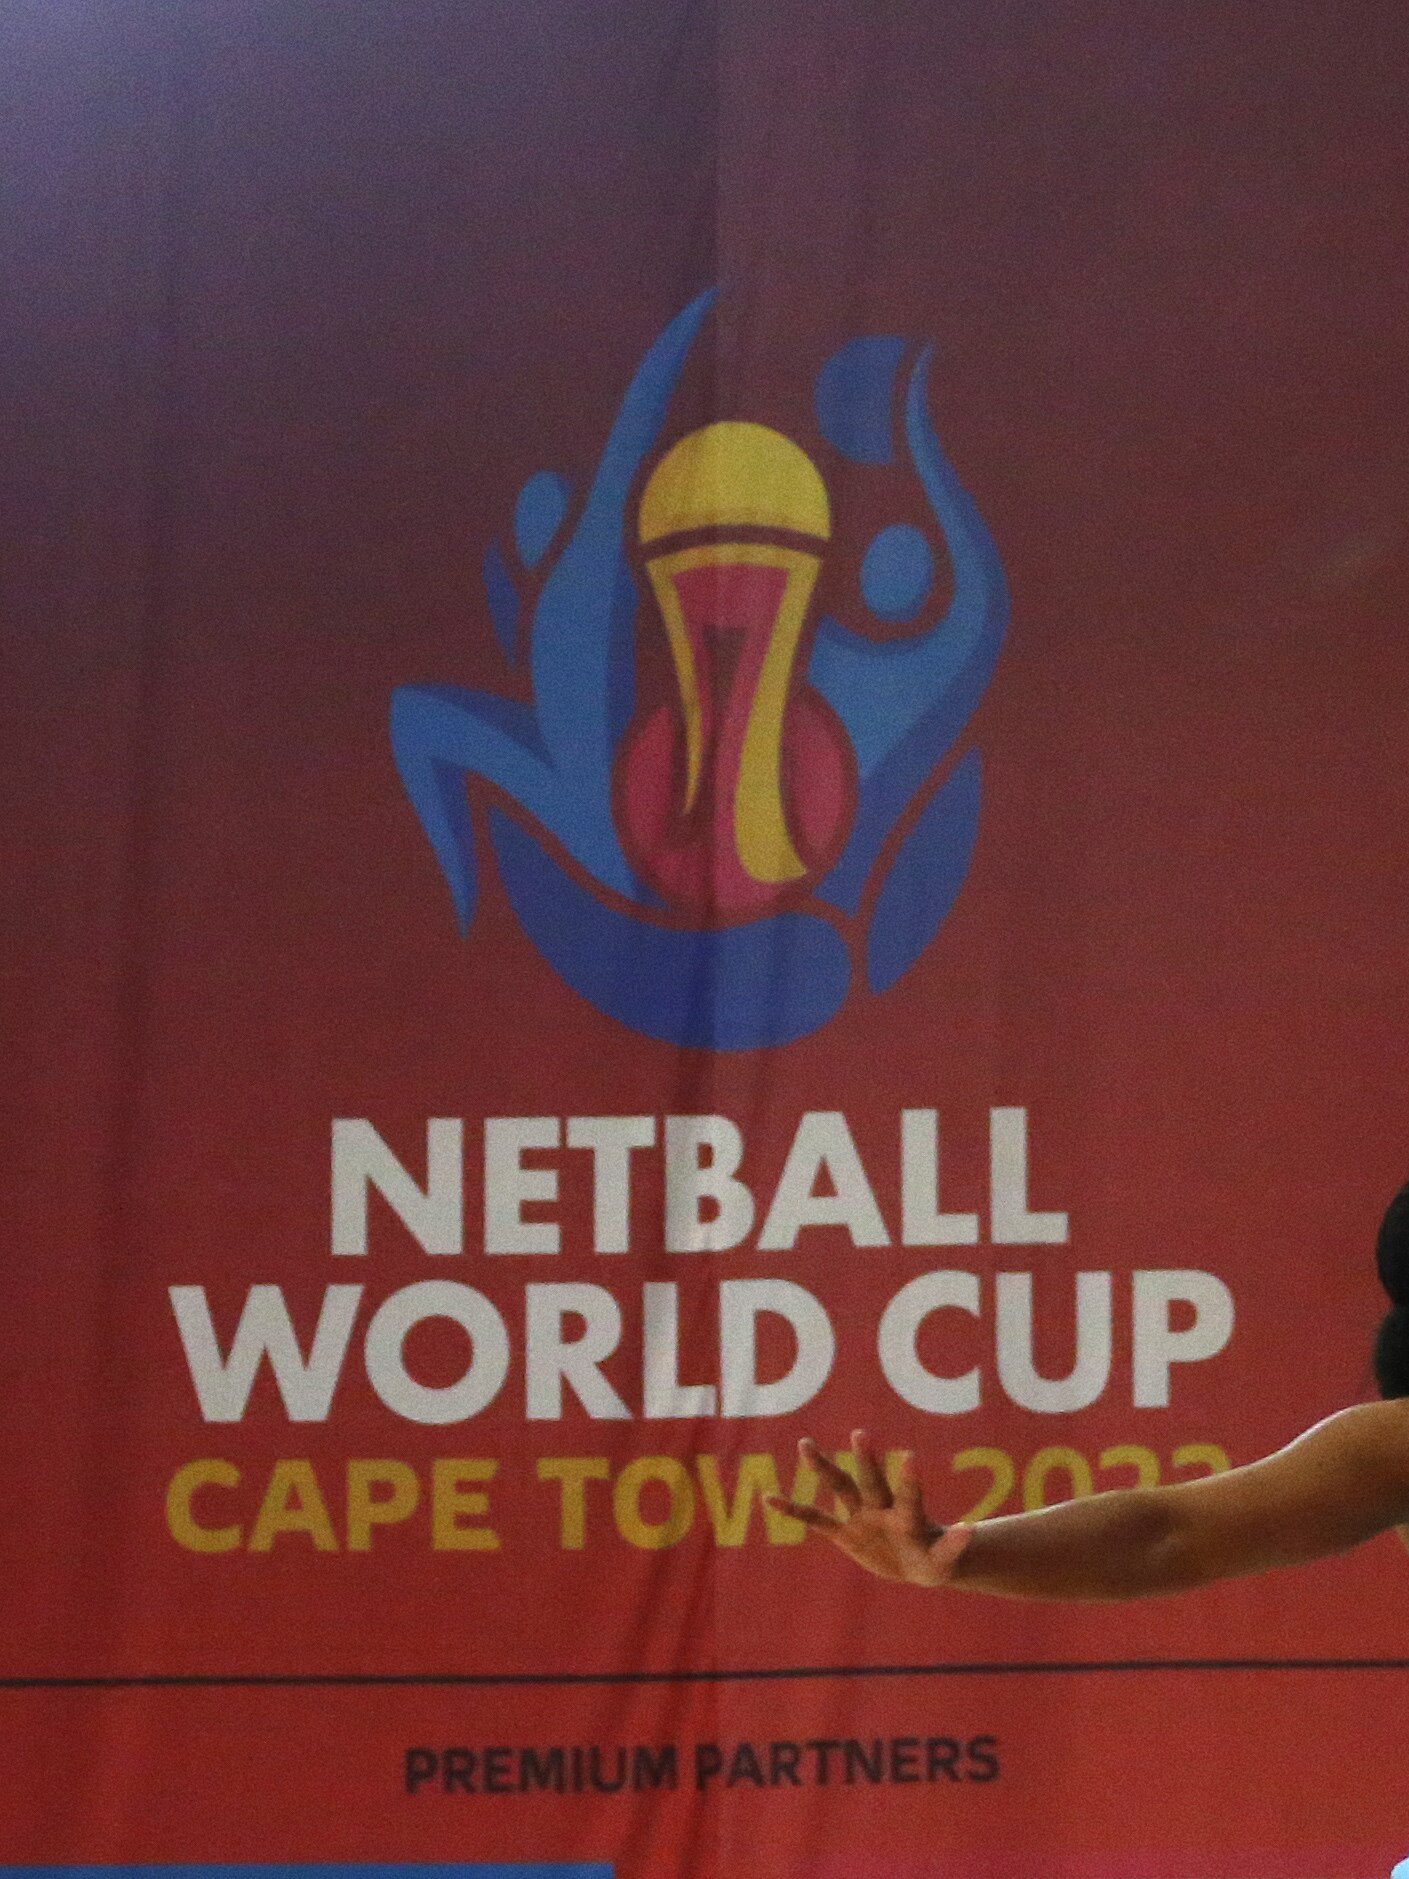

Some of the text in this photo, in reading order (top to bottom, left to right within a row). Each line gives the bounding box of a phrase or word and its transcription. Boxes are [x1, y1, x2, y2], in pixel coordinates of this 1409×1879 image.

[330, 1106, 1069, 1257] NETBALL
[168, 1269, 1236, 1425] WORLD CUP
[165, 1456, 502, 1553] CAPE
[405, 1735, 999, 1796] PREMIUM PARTNERS
